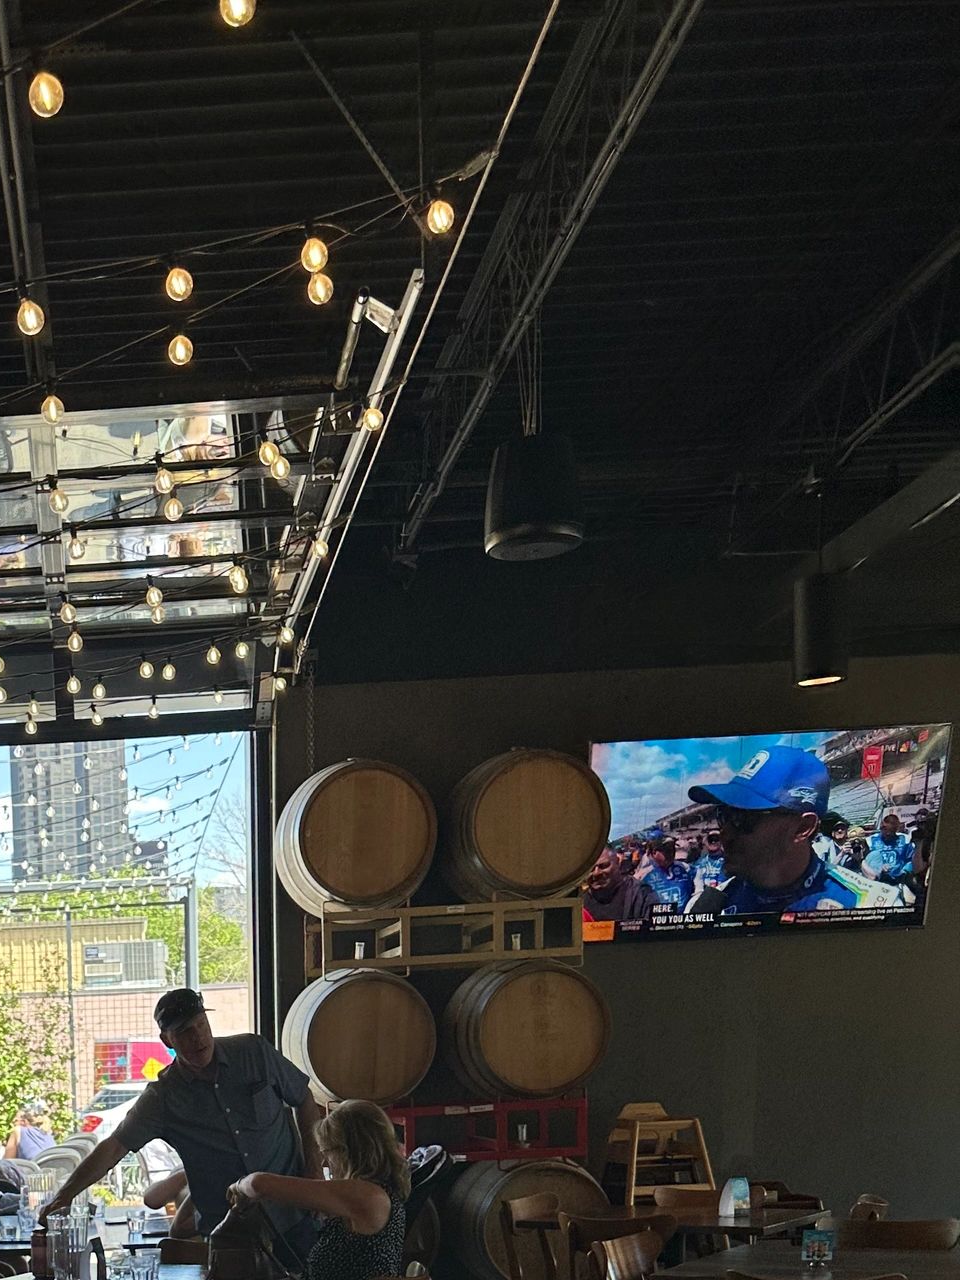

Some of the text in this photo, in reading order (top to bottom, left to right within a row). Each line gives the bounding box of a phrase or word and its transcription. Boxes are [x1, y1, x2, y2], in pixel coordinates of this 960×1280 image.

[652, 904, 674, 913] HERE.
[651, 913, 714, 925] YOU YOU AS WELL
